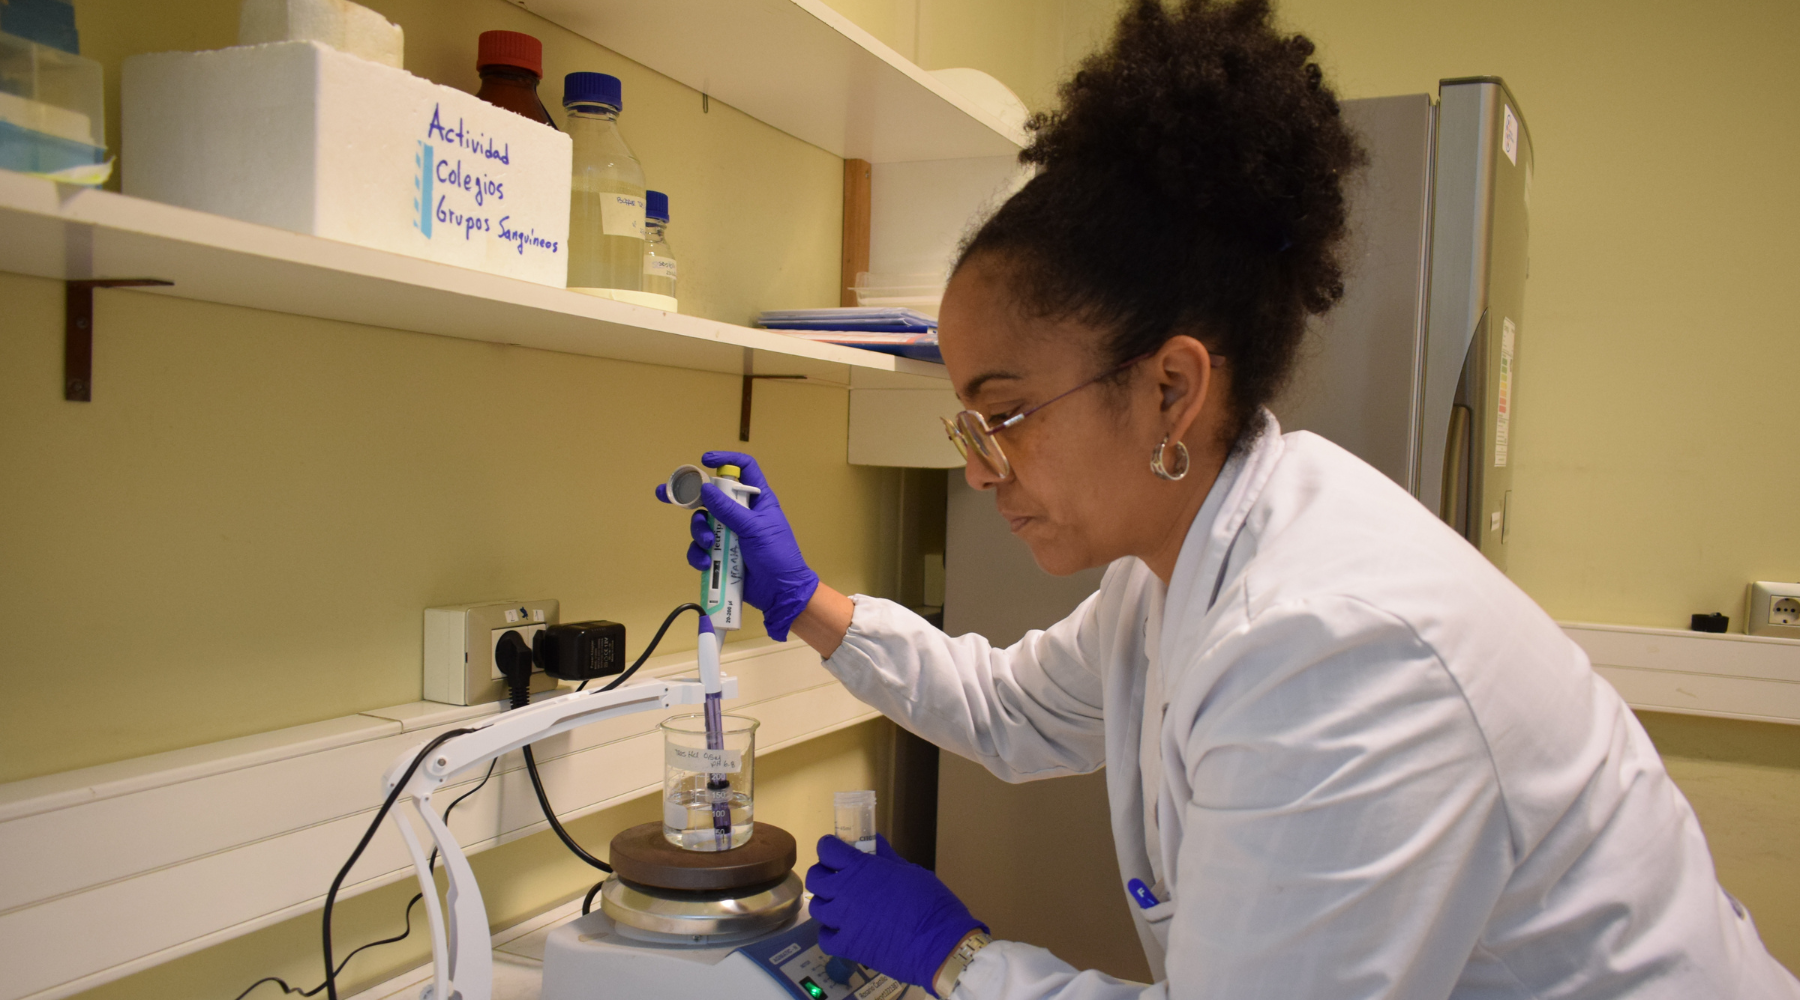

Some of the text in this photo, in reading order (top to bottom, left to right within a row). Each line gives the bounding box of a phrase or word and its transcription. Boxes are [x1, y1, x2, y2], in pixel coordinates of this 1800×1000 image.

[427, 102, 510, 166] Actividad
[436, 159, 504, 207] Colegios
[436, 194, 558, 255] Grupos Sanguíneos
[711, 773, 726, 781] 200
[712, 791, 726, 799] 150
[712, 809, 726, 818] 100
[715, 828, 726, 836] 50
[1136, 887, 1146, 898] F
